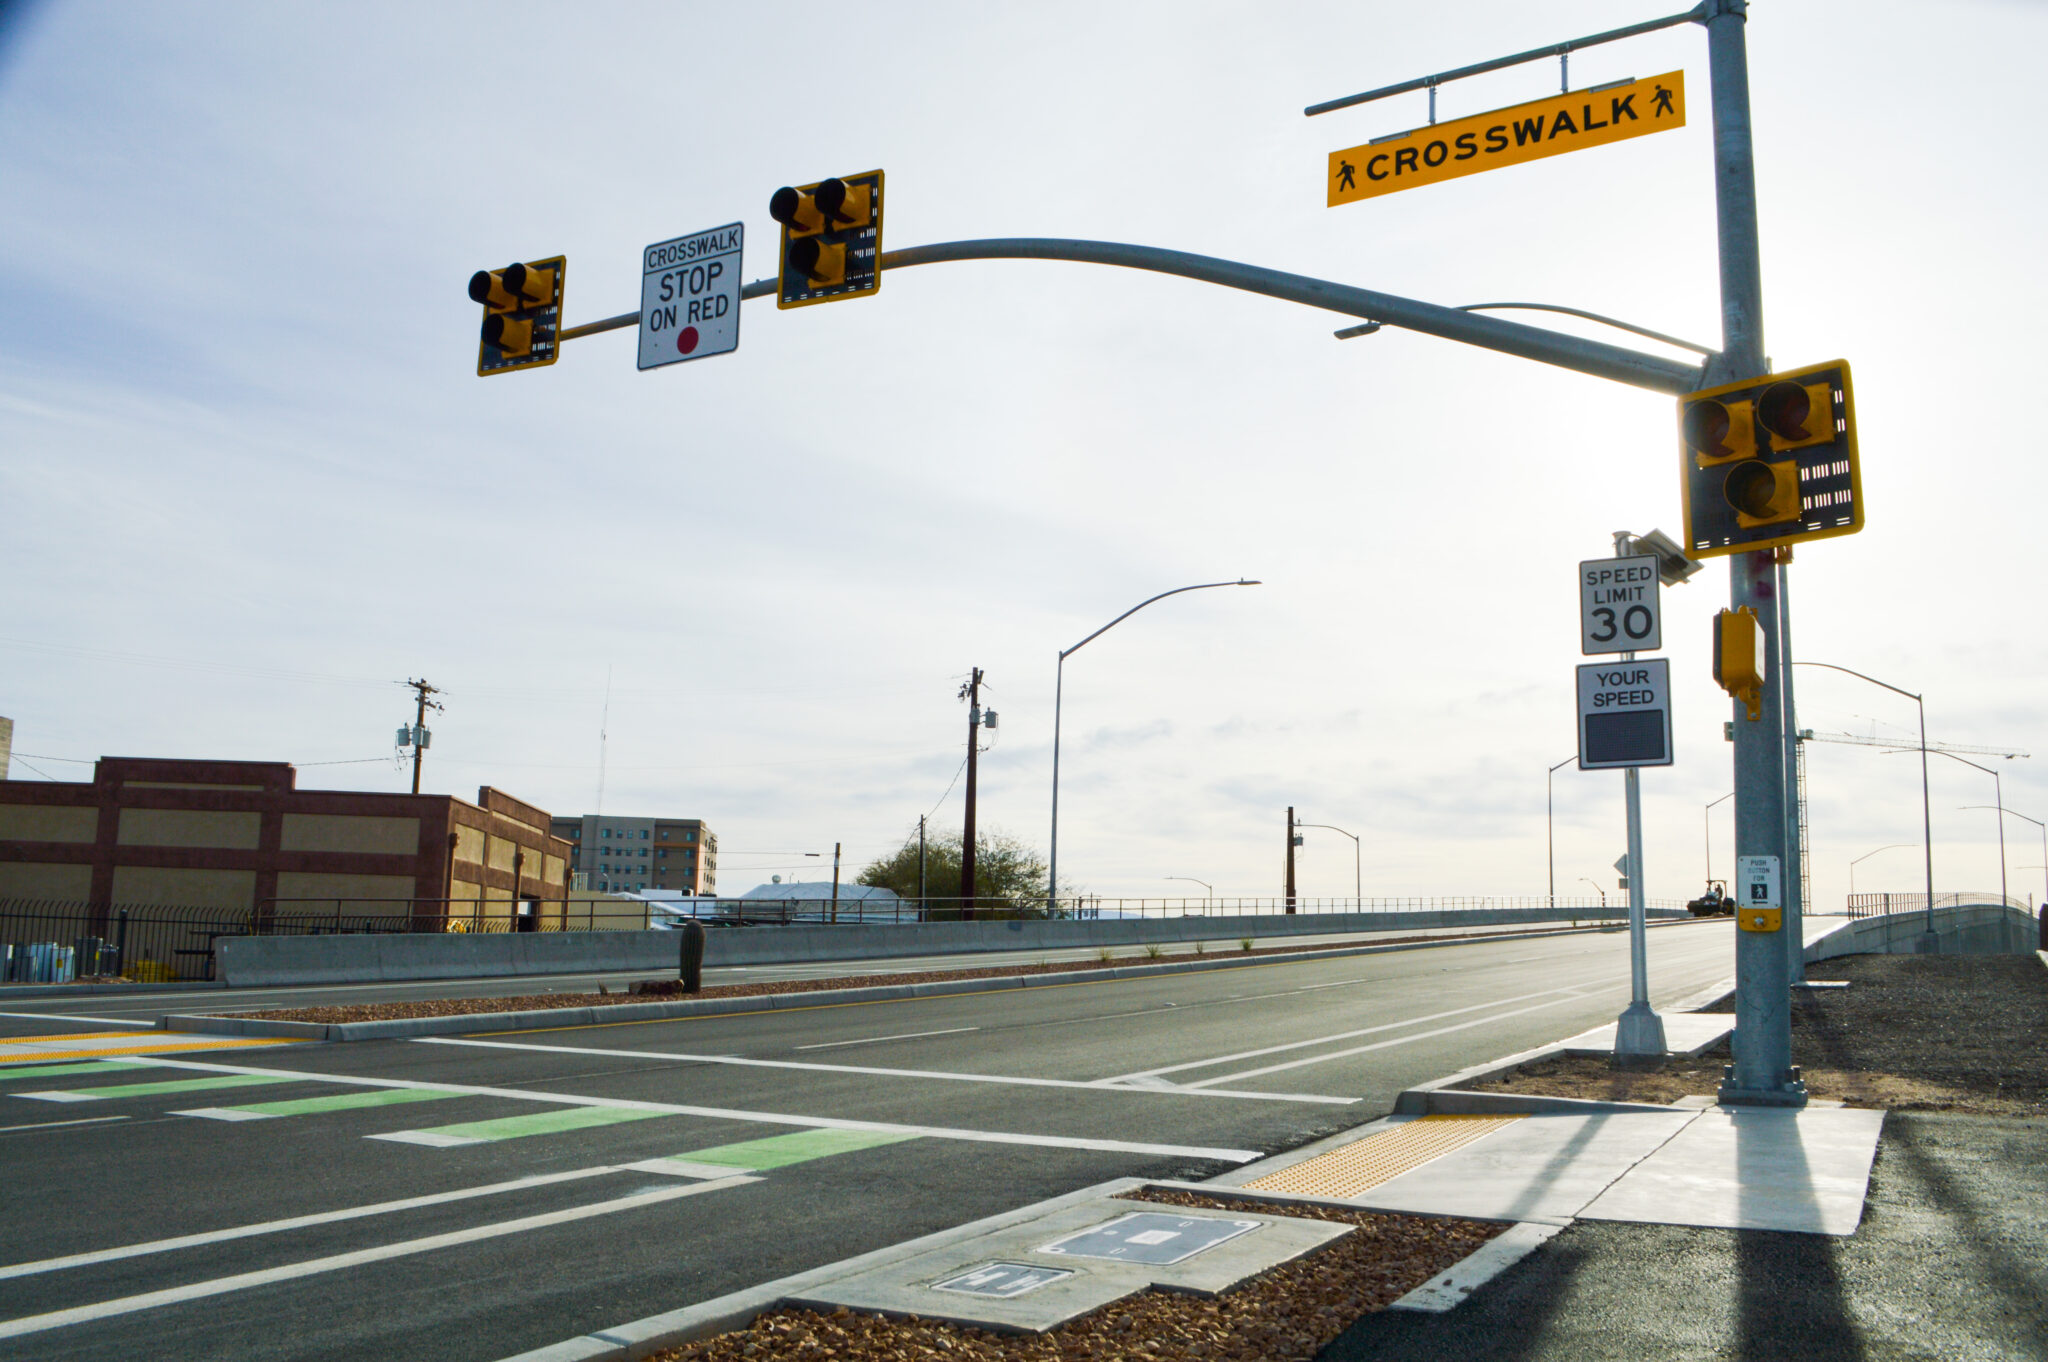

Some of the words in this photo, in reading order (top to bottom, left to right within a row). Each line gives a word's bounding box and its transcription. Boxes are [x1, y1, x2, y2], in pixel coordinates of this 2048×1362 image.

[1366, 93, 1639, 181] CROSSWALK
[648, 229, 739, 268] CROSSWALK
[659, 261, 724, 303] STOP
[650, 307, 677, 332] ON
[688, 294, 729, 323] RED
[1586, 566, 1652, 586] SPEED
[1594, 586, 1645, 604] LIMIT
[1590, 605, 1653, 642] 30
[1596, 670, 1650, 687] YOUR
[1593, 690, 1655, 707] SPEED
